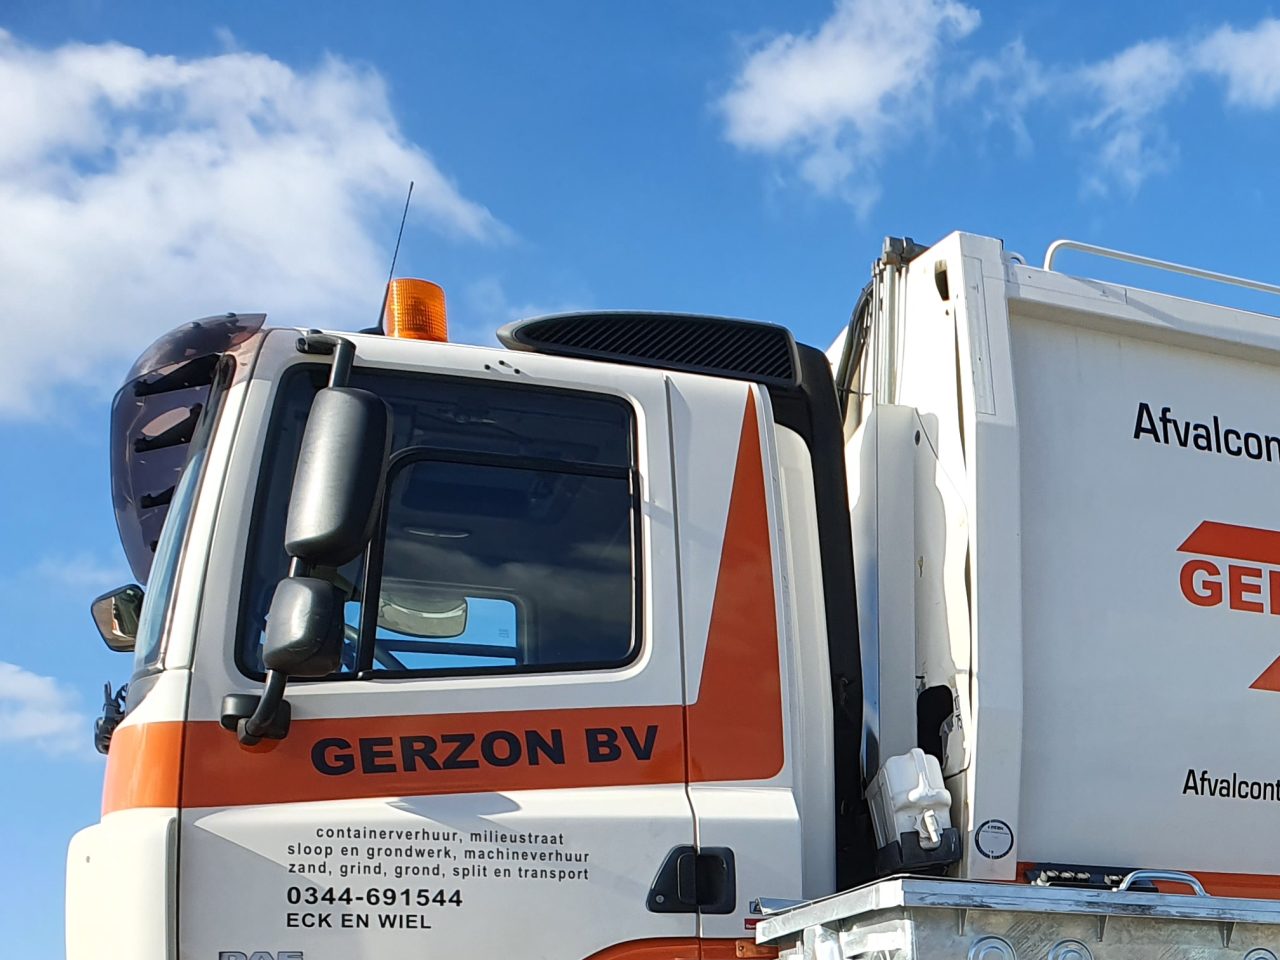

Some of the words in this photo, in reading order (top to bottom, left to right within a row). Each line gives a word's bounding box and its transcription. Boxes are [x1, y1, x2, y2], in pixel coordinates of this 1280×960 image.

[310, 728, 566, 776] GERZON
[584, 725, 659, 763] BV
[316, 826, 463, 844] containerverhuur,
[470, 830, 564, 845] milieustraat
[287, 843, 333, 858] sloop
[341, 846, 359, 856] en
[367, 845, 457, 860] grondwerk,
[464, 848, 590, 862] machineverhuur
[288, 861, 332, 876] zand,
[340, 862, 387, 877] grind,
[394, 863, 445, 878] grond,
[452, 864, 488, 879] split
[494, 867, 511, 877] en
[518, 866, 589, 881] transport
[287, 886, 463, 907] 0344-691544
[287, 912, 332, 928] ECK
[341, 913, 369, 928] EN
[378, 914, 432, 929] WIEL
